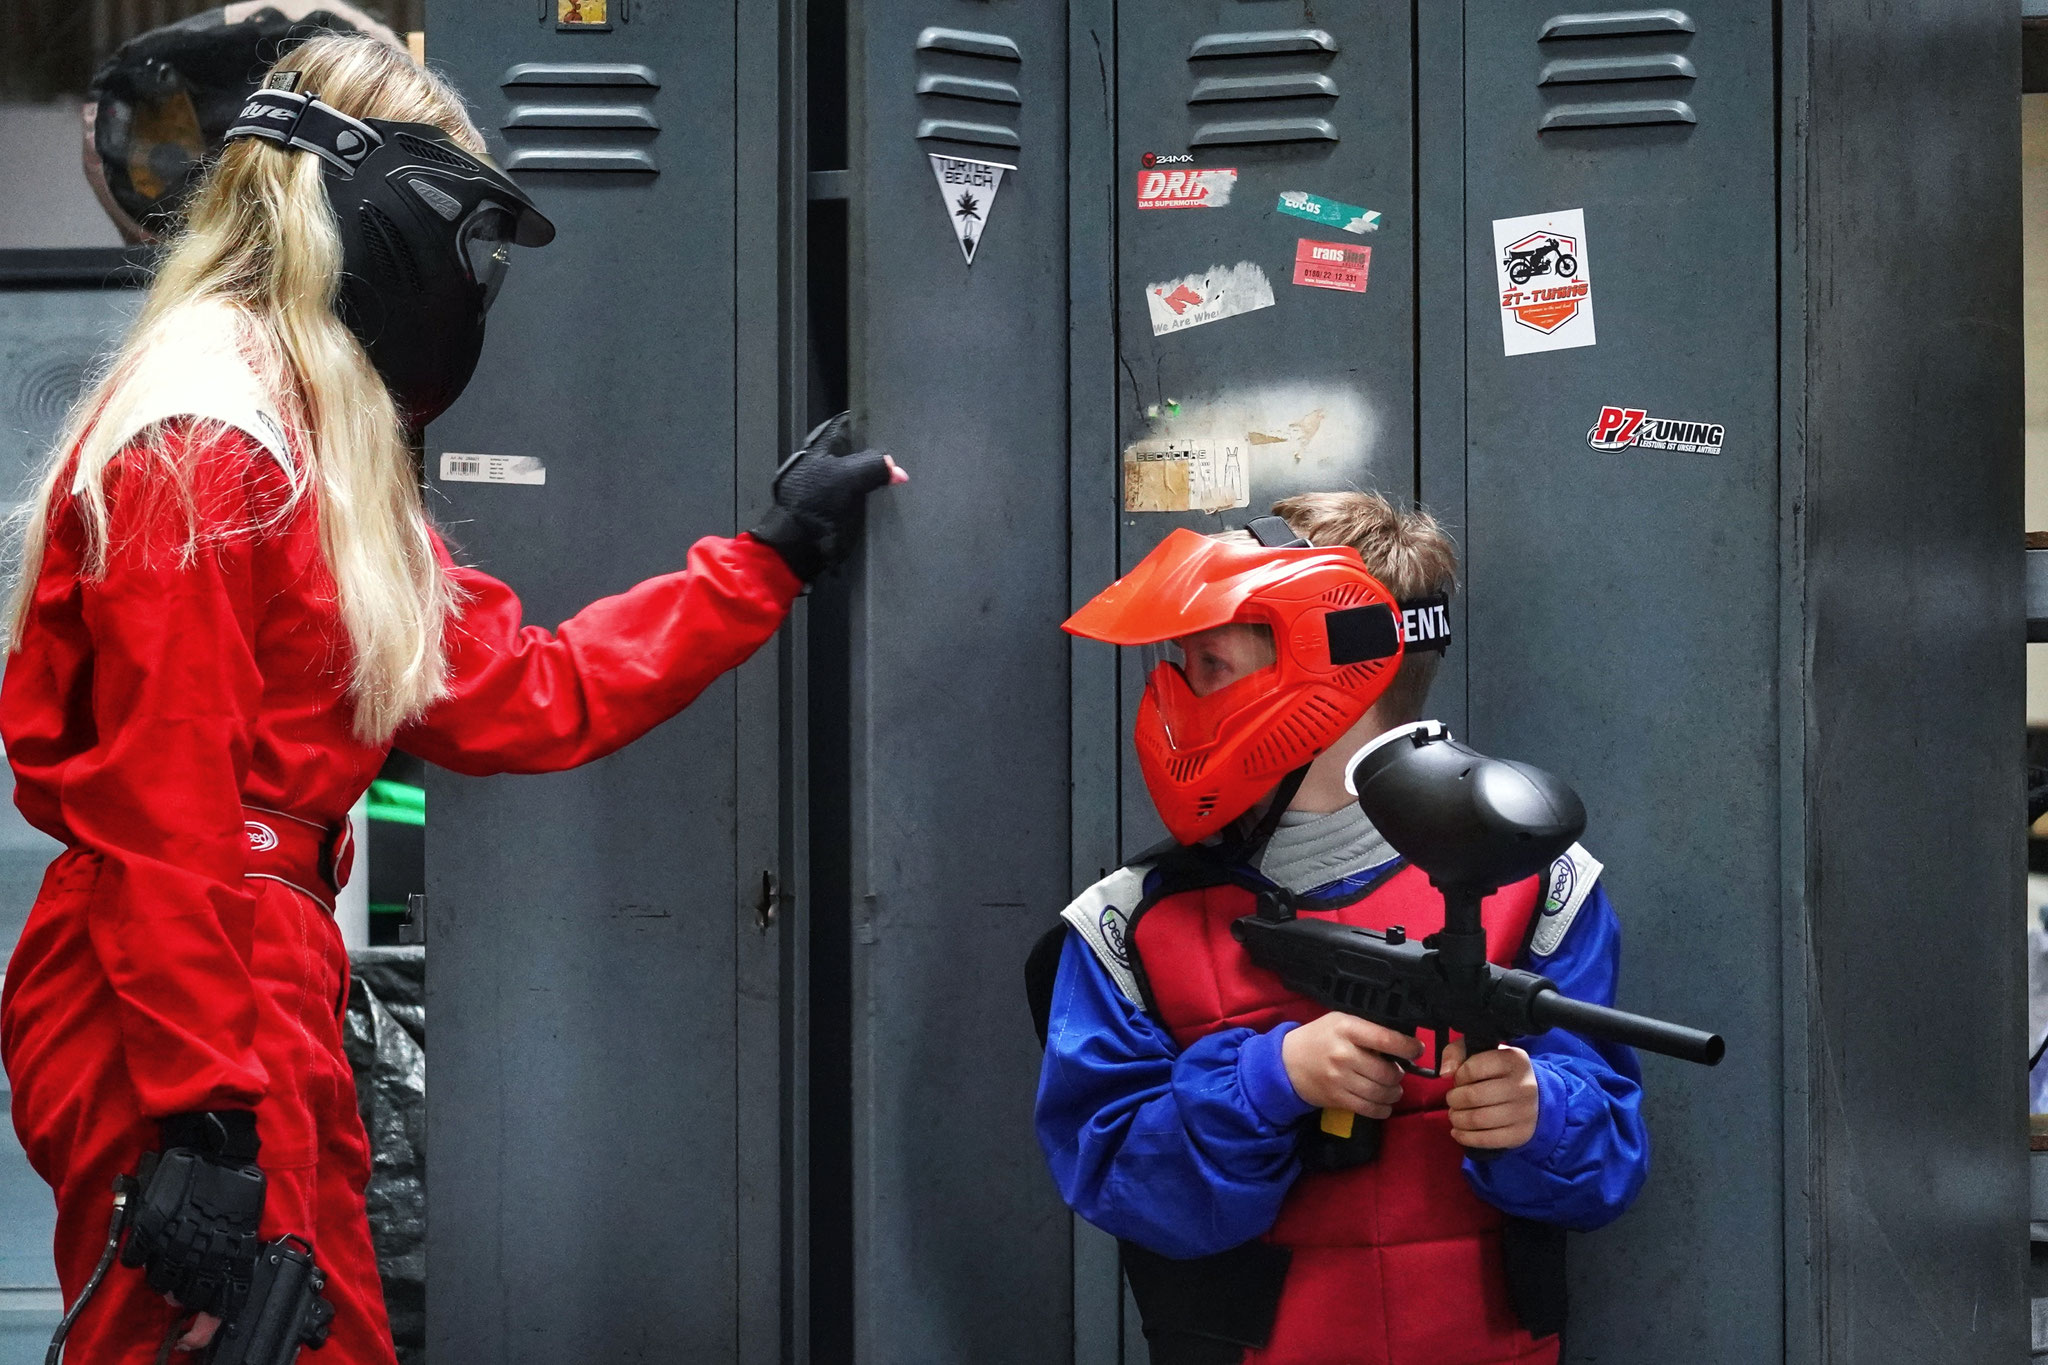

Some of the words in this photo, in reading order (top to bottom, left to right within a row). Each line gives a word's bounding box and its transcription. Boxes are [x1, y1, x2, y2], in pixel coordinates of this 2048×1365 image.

[239, 102, 297, 120] dye
[1156, 154, 1194, 164] 24MX
[945, 171, 993, 190] BEACH
[1502, 283, 1588, 307] ZT-TUNING
[1154, 323, 1168, 333] We
[1172, 318, 1191, 328] Are
[1594, 407, 1646, 442] PZ
[1667, 442, 1677, 450] IST
